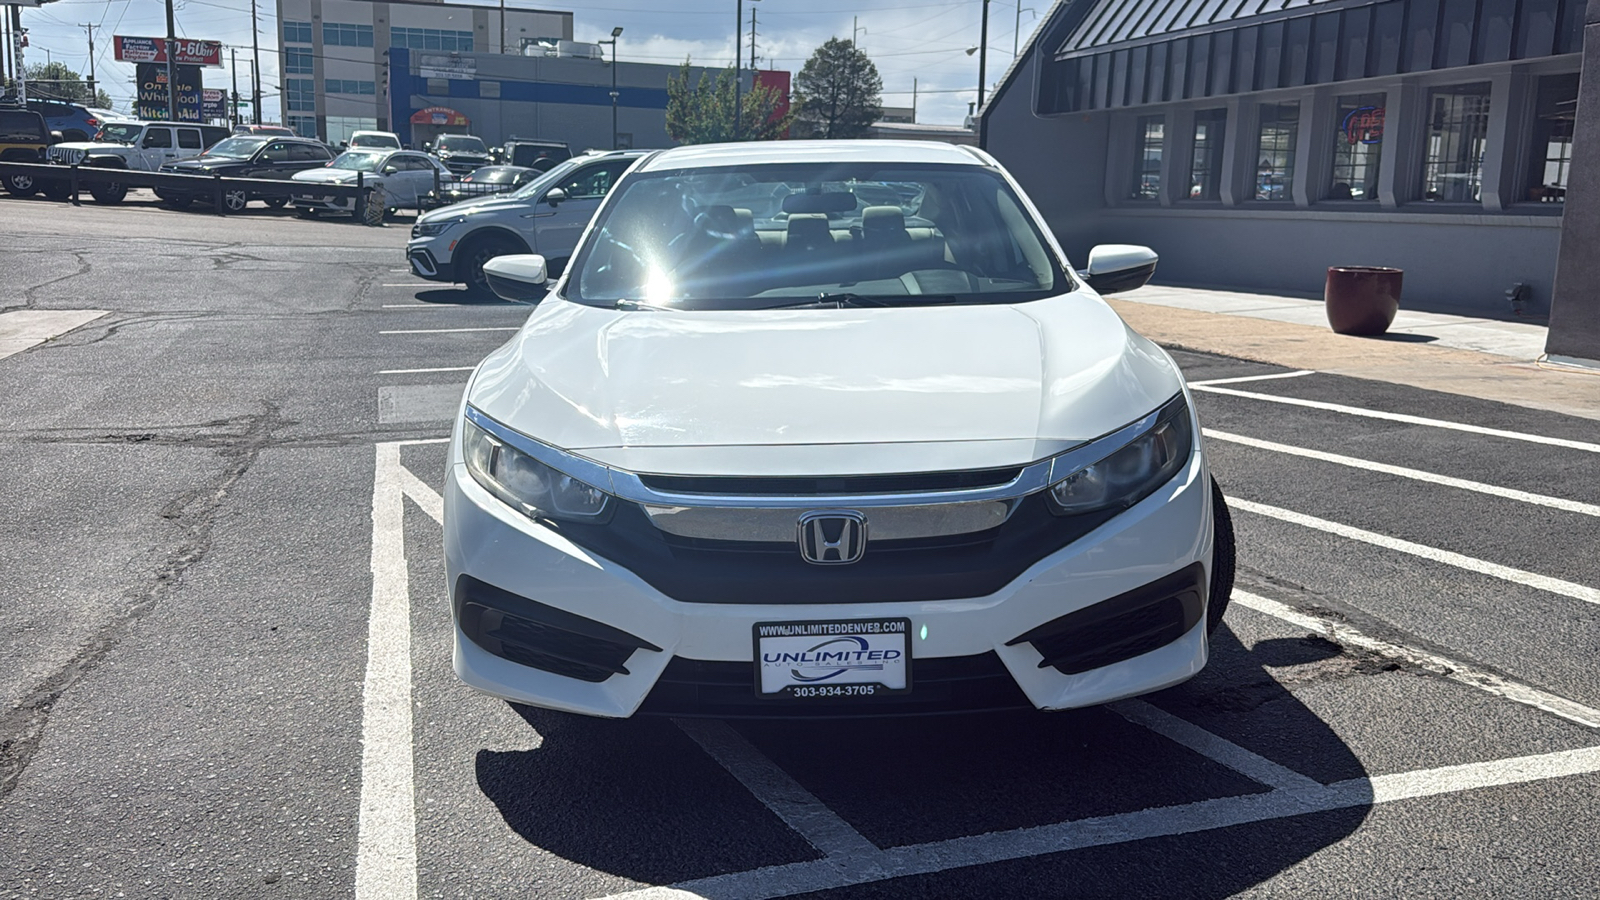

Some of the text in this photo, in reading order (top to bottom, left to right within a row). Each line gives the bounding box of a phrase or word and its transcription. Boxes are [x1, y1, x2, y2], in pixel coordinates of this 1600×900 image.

[144, 82, 162, 90] On
[424, 107, 455, 115] ENTRANCE
[763, 649, 901, 662] UNLIMITED
[794, 686, 874, 697] 303-934-3705
